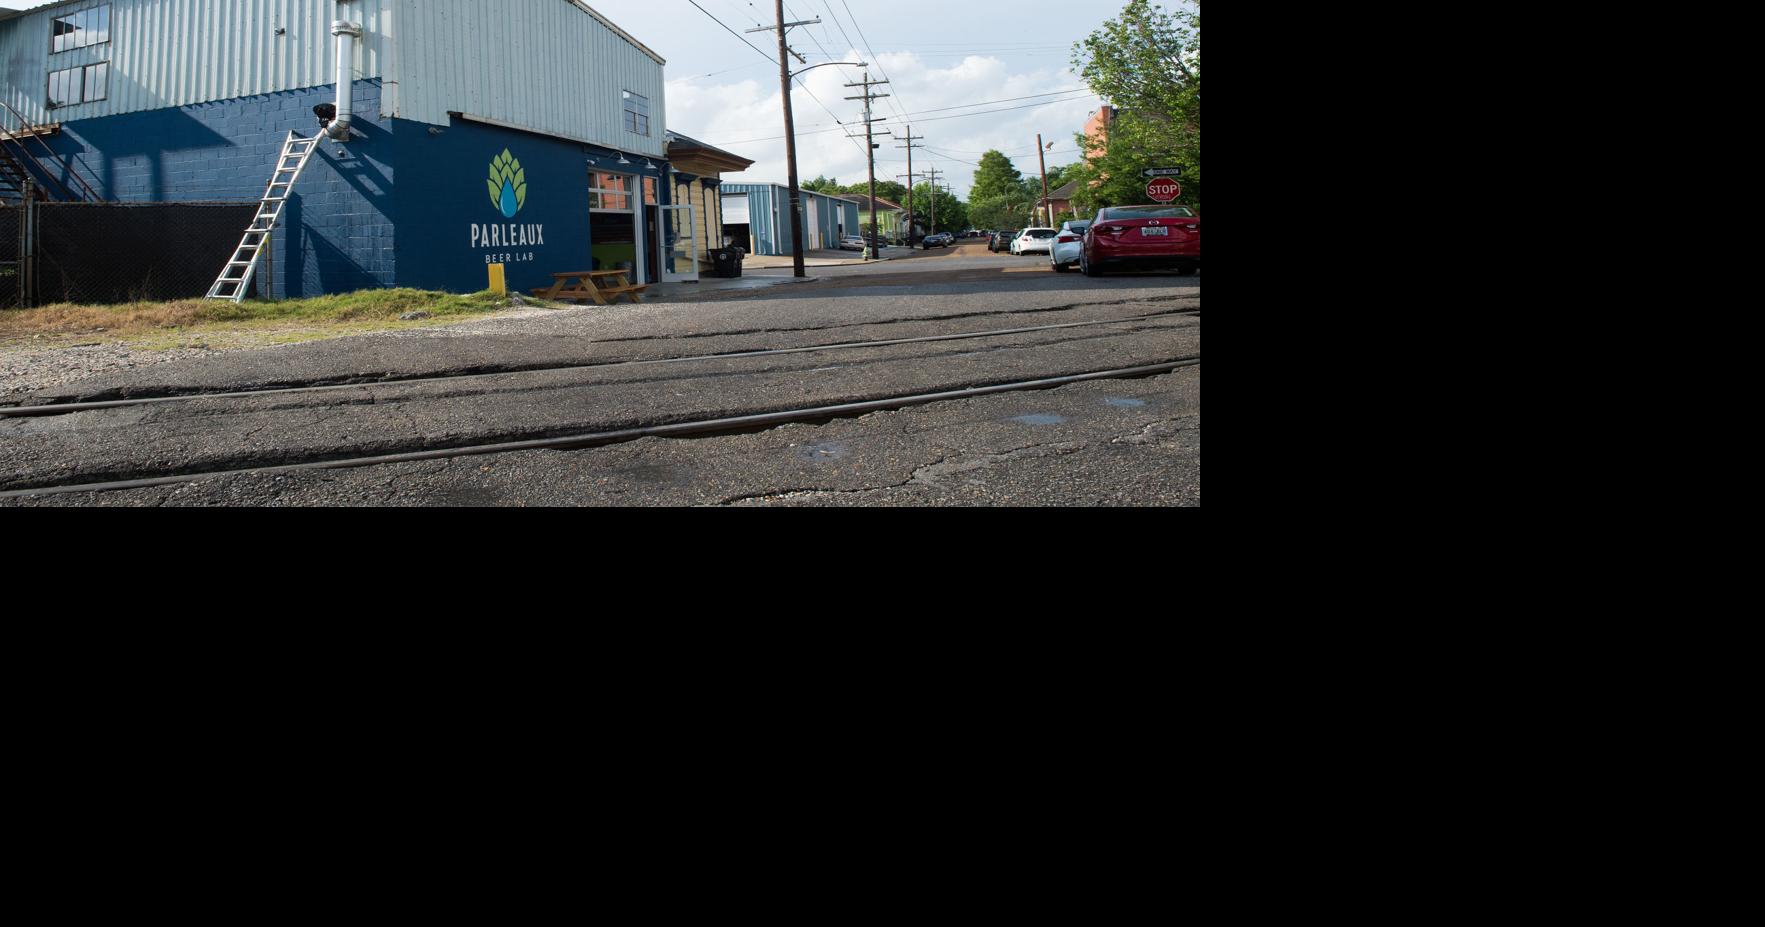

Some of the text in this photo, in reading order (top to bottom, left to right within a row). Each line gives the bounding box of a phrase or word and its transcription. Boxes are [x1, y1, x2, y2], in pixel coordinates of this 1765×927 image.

[1149, 185, 1177, 194] STOP
[471, 223, 544, 248] PARLEAUX
[485, 252, 534, 263] BEER LAB
